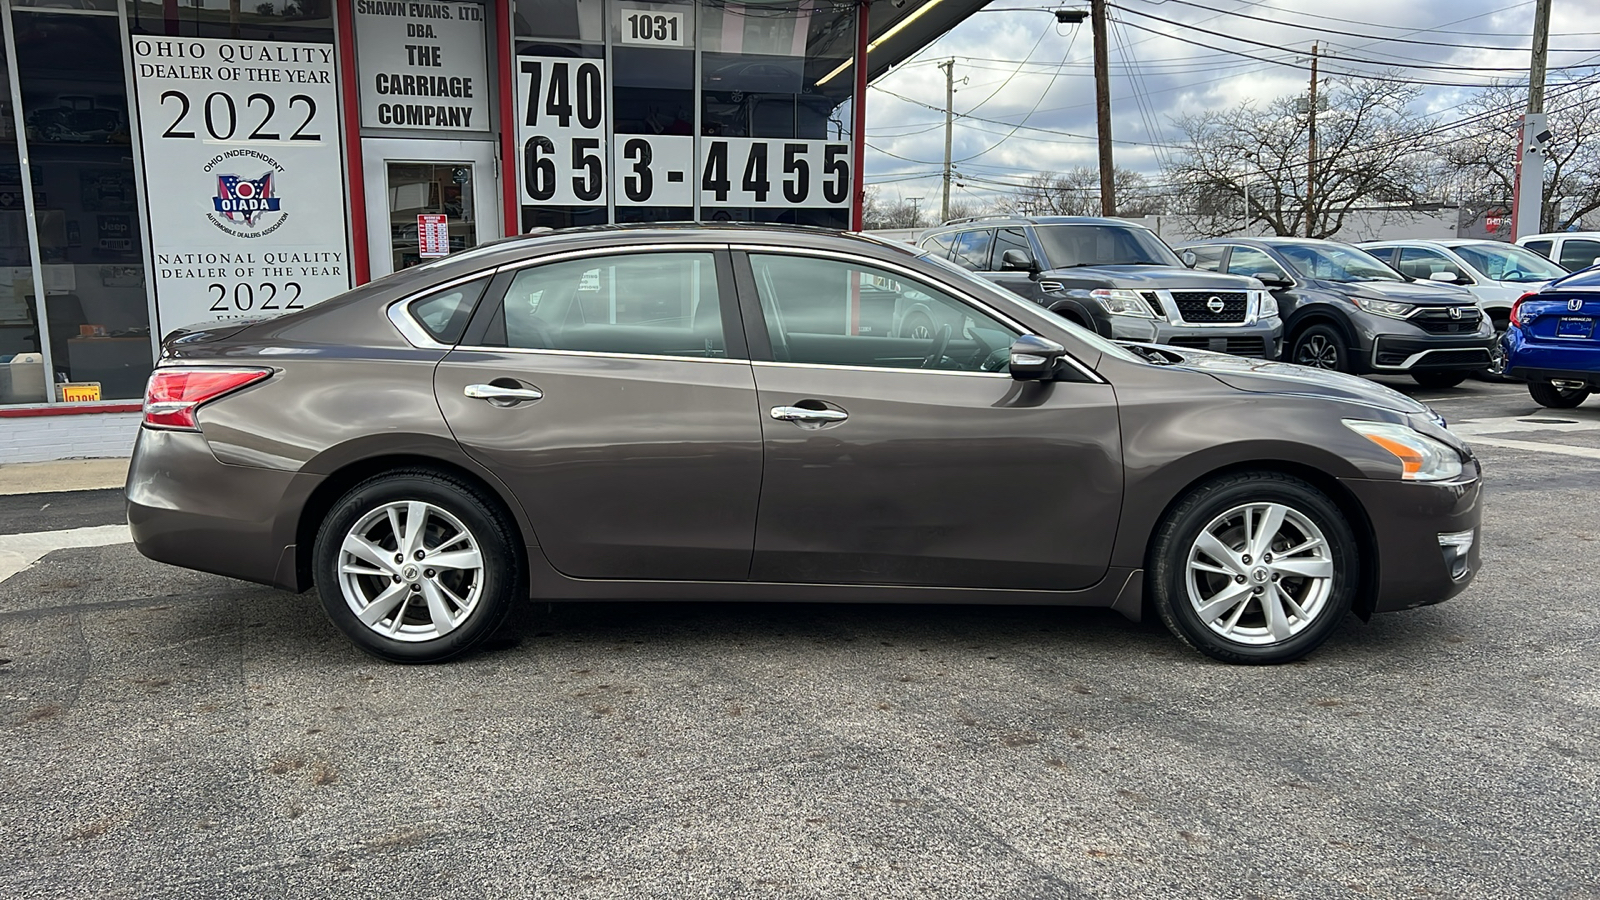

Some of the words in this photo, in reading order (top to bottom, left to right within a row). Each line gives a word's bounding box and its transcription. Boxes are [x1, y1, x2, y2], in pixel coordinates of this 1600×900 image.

[358, 1, 406, 17] SHAWN
[458, 6, 483, 22] LTD.
[407, 23, 437, 39] DBA.
[627, 14, 678, 41] 1031
[135, 40, 205, 59] OHIO
[218, 44, 332, 64] QUALITY
[405, 45, 441, 67] THE
[140, 64, 213, 80] DEALER
[217, 67, 241, 81] OF
[245, 68, 281, 82] THE
[285, 69, 331, 84] YEAR
[375, 73, 473, 98] CARRIAGE
[520, 60, 603, 129] 740
[160, 90, 322, 141] 2022
[378, 103, 473, 127] COMPANY
[203, 155, 223, 173] OHIO
[223, 149, 285, 173] INDEPENDENT
[221, 199, 269, 210] OIADA
[101, 221, 127, 233] Jeep
[206, 212, 236, 237] AUTOMOBILE
[261, 212, 289, 236] ASSOCIATION
[158, 253, 256, 264] NATIONAL
[264, 252, 342, 265] QUALITY
[161, 268, 227, 279] DEALER
[234, 267, 255, 278] OF
[262, 267, 294, 277] THE
[301, 266, 341, 276] YEAR
[208, 282, 304, 311] 2022
